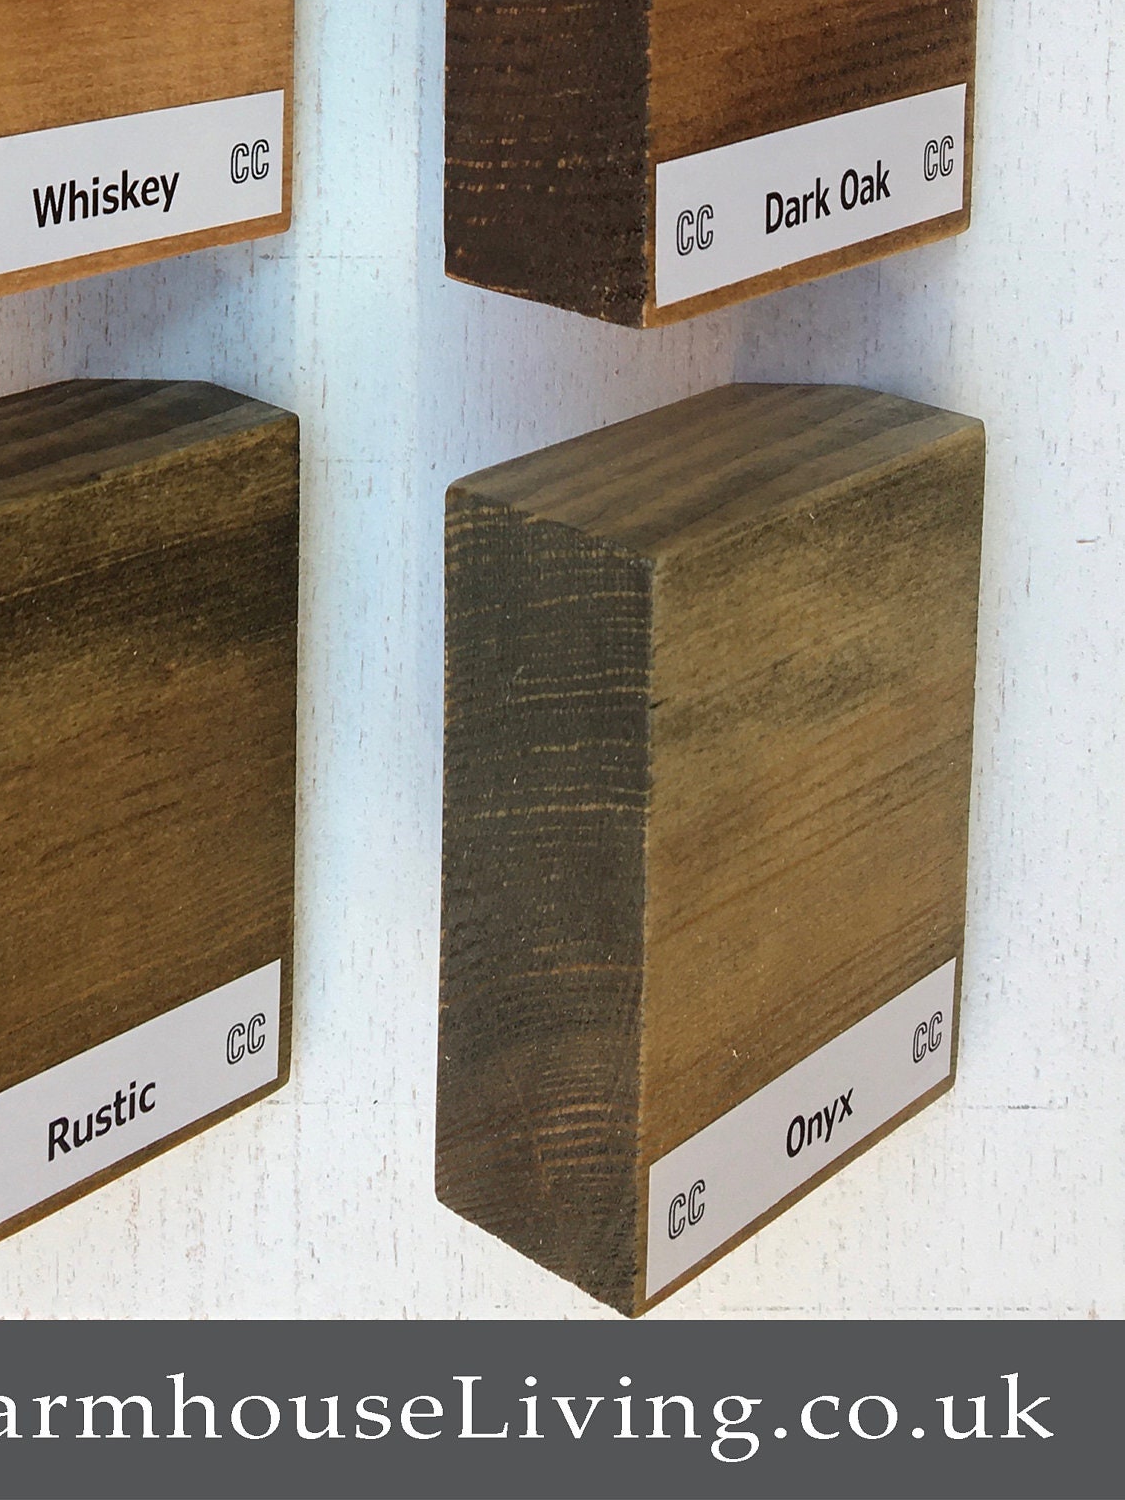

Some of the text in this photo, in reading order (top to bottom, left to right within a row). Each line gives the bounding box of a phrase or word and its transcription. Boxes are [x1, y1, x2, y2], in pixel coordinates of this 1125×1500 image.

[32, 168, 180, 229] Whiskey
[230, 138, 270, 185] CC
[676, 134, 955, 257] CC Dark Oak CC
[47, 1080, 156, 1163] Rustic
[226, 1012, 267, 1066] CC
[667, 1010, 943, 1241] CC Onyx CC
